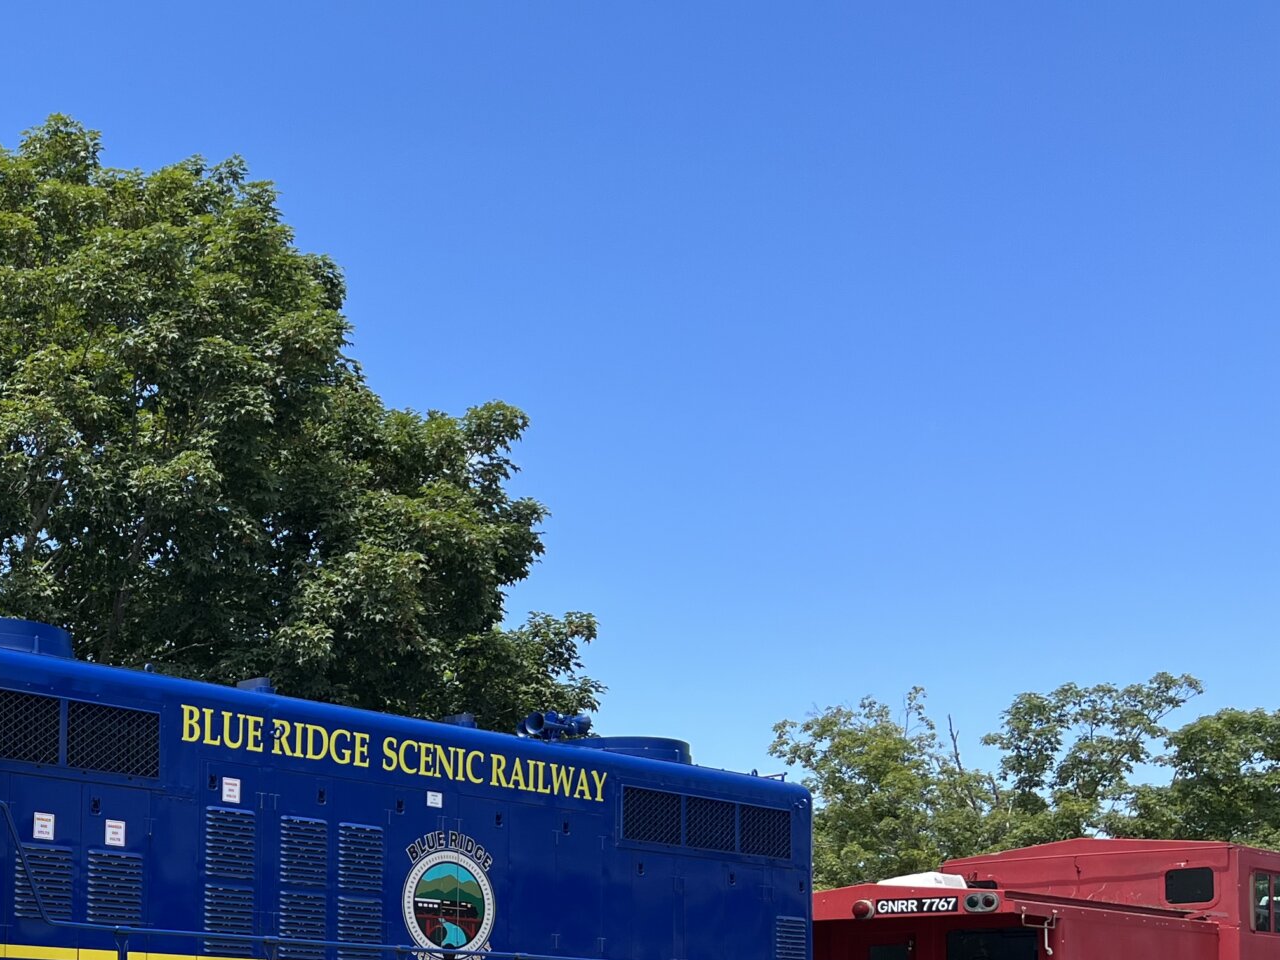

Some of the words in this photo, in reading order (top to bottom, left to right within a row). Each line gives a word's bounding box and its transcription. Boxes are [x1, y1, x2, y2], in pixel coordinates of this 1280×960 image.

[181, 703, 264, 753] BLUE
[271, 717, 370, 768] RIDGE
[382, 736, 484, 784] SCENIC
[490, 753, 608, 802] RAILWAY
[406, 830, 445, 864] BLUE
[448, 830, 493, 872] RIDGE
[877, 900, 918, 913] GNRR
[922, 897, 957, 911] 7767
